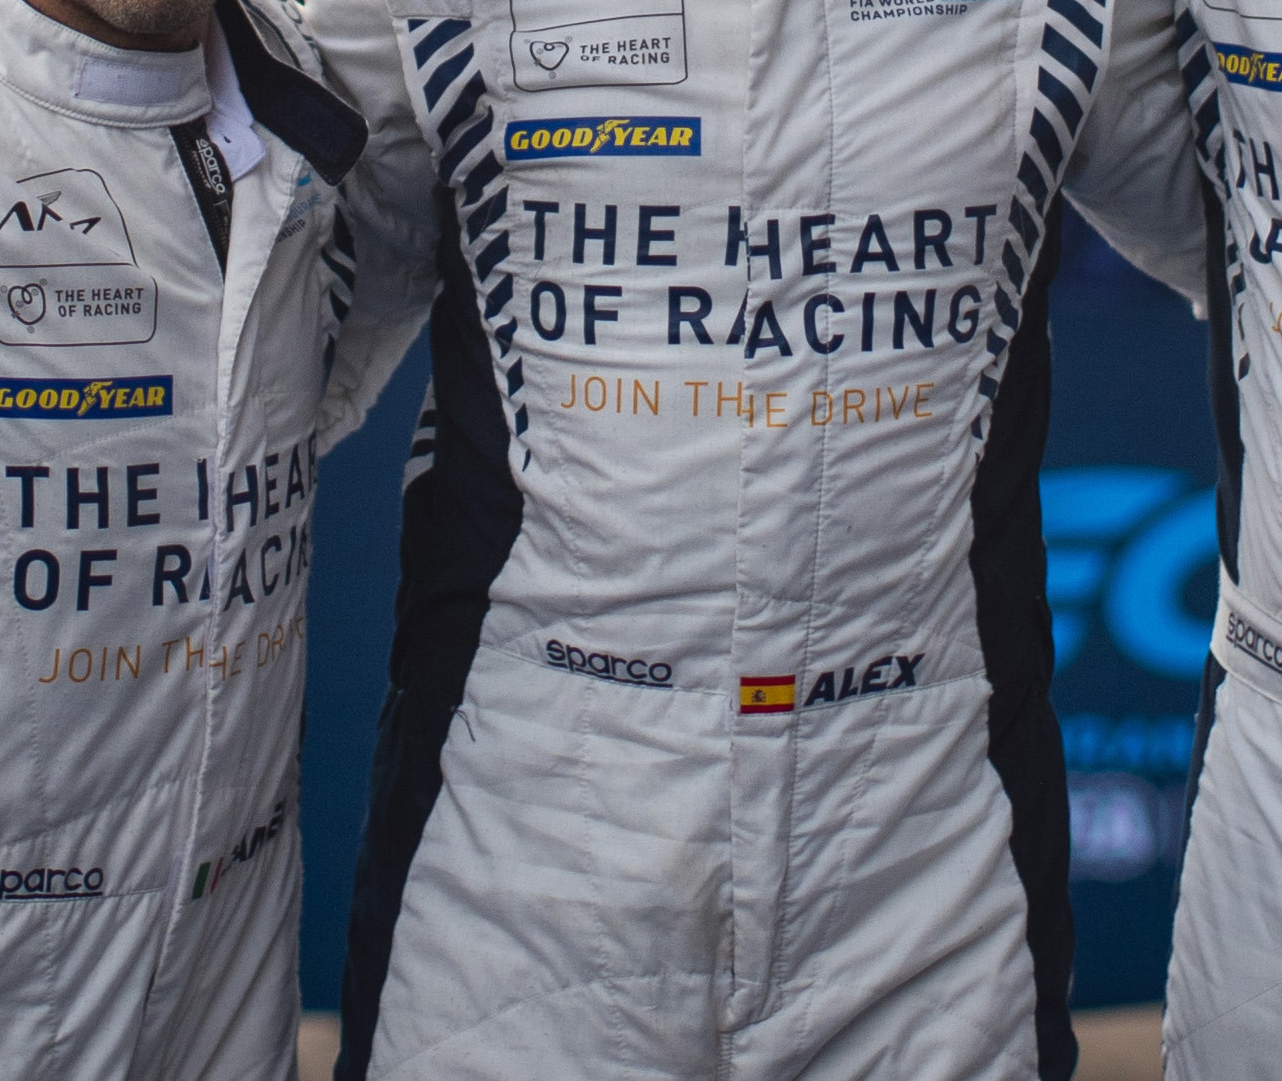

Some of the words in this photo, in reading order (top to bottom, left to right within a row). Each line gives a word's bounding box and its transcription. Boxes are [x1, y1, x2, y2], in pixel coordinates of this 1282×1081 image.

[850, 4, 968, 21] CHAMPIONSHIP
[580, 42, 610, 54] THE
[617, 37, 671, 52] HEART
[580, 54, 601, 62] OF
[608, 52, 670, 65] RACING
[510, 123, 694, 152] GOODYEAR
[523, 200, 681, 267] THE
[724, 203, 997, 281] HEART
[55, 289, 85, 303] THE
[92, 288, 144, 302] HEART
[58, 305, 77, 317] OF
[83, 302, 142, 317] RACING
[530, 280, 623, 346] OF
[667, 283, 982, 359] RACING
[560, 374, 660, 417] JOIN
[684, 380, 788, 429] THE
[810, 382, 935, 428] DRIVE
[5, 462, 161, 530] THE
[196, 433, 318, 533] HEAR
[13, 548, 118, 612] OF
[151, 522, 309, 613] RACIN
[37, 644, 141, 684] JOIN
[161, 636, 246, 682] THE
[546, 638, 673, 688] sparco
[803, 653, 926, 707] ALEX
